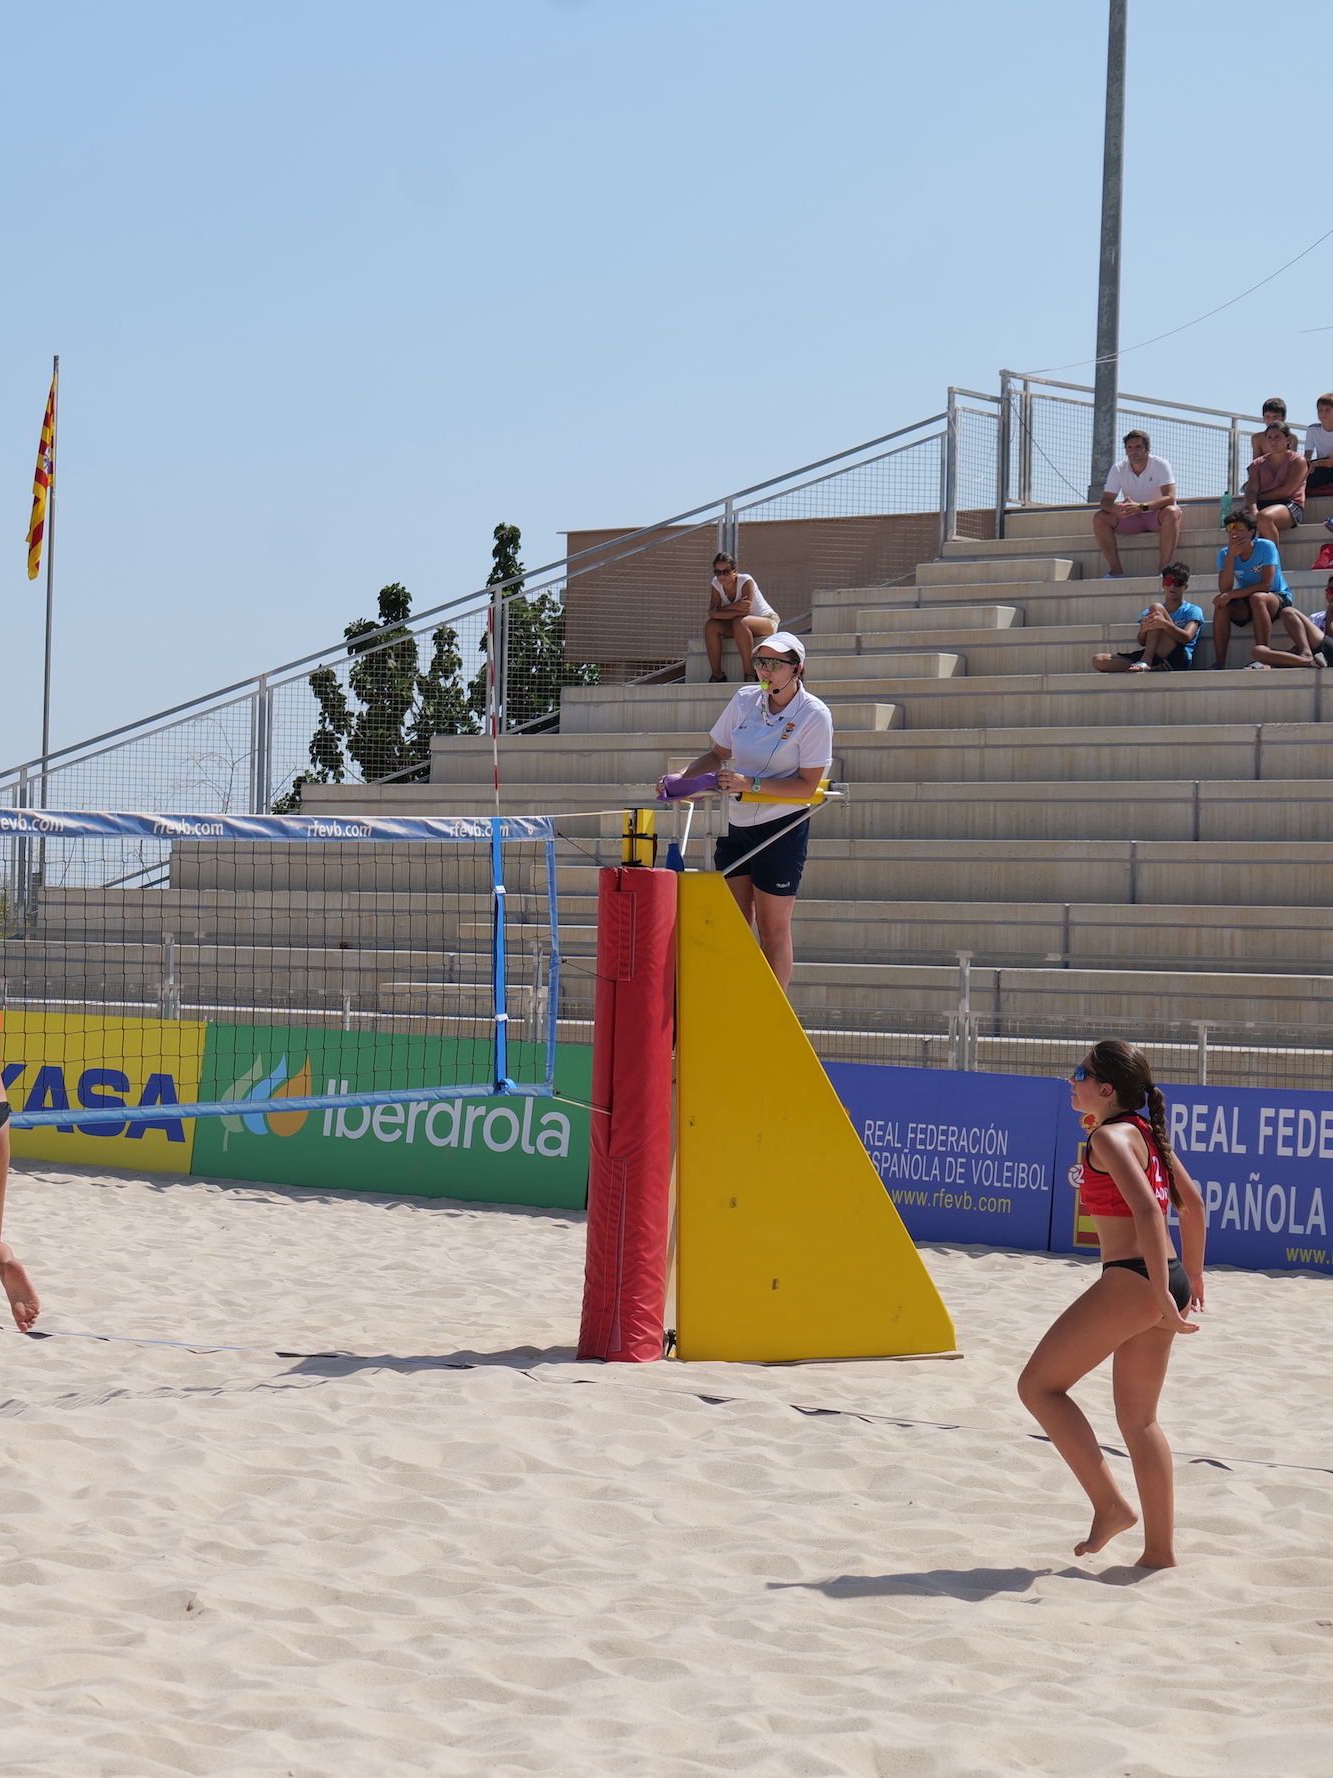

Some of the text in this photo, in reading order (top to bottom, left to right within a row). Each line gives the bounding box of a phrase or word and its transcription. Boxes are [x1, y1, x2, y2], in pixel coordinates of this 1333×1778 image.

[153, 817, 224, 836] rfevb.com
[307, 819, 372, 838] rfevb.com
[449, 820, 509, 838] rfevb.cm
[321, 1078, 572, 1158] Iberdrola
[1170, 1103, 1247, 1154] REAL
[864, 1119, 1009, 1156] REAL FEDERACIÓN
[866, 1148, 1049, 1191] SPAÑOLA DE VOLEIBOL
[1152, 1155, 1164, 1182] 2
[891, 1187, 1012, 1214] www.rfevb.com
[1168, 1171, 1327, 1236] PAÑOLA
[1285, 1247, 1333, 1265] www.
